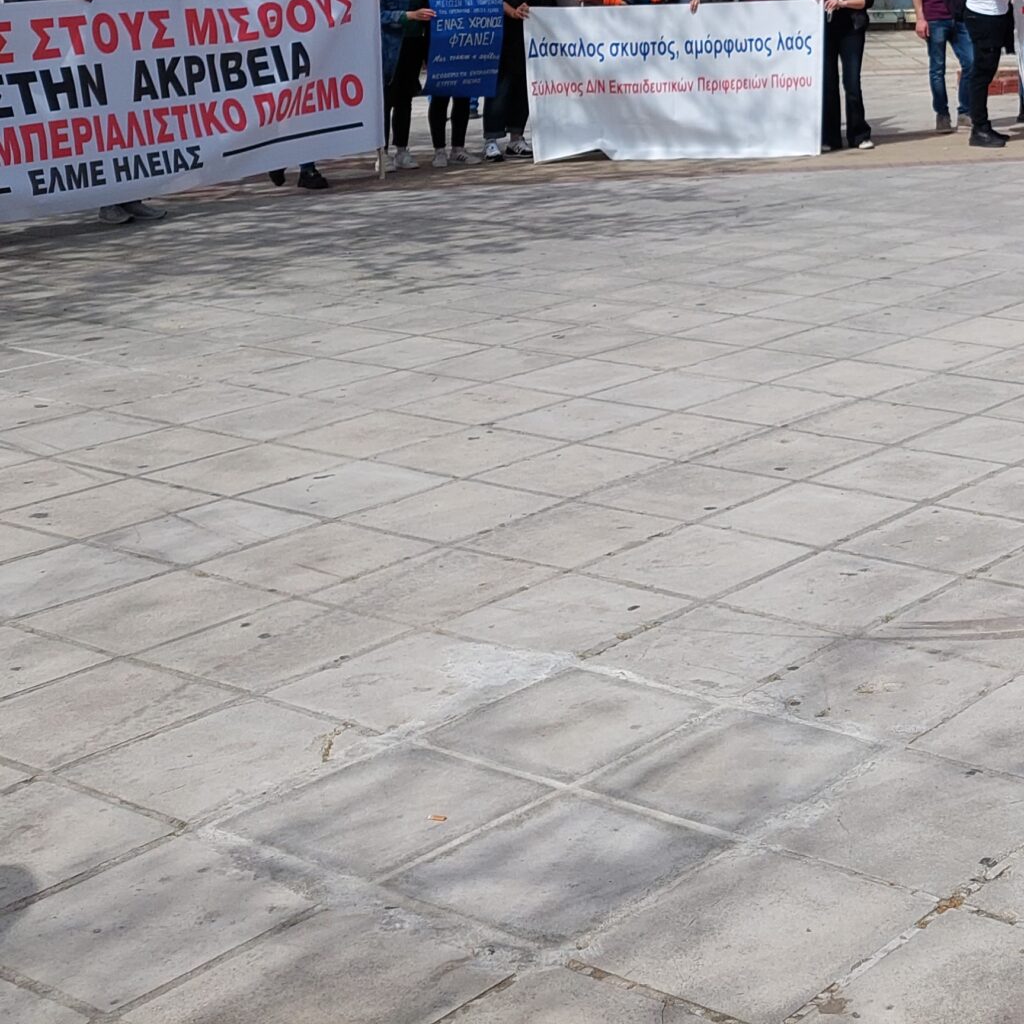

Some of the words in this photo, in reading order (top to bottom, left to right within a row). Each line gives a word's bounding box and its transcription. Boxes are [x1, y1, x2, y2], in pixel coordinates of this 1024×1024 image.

[30, 10, 175, 62] ΣΤΟΥΣ
[528, 36, 604, 62] Δάσκαλος
[609, 35, 680, 62] σκυφτός,
[684, 34, 772, 61] αμόρφωτος
[777, 31, 812, 55] λαός
[133, 41, 311, 103] ΑΚΡΙΒΕΙΑ
[531, 80, 583, 97] Σύλλογος
[609, 77, 693, 95] Εκπαιδευτικών
[697, 75, 768, 93] Περιφερειών
[771, 74, 812, 91] Πύργου
[253, 74, 364, 128] ΠΟΛΕΜΟ
[28, 160, 107, 197] ΕΛΜΕ
[113, 145, 205, 183] ΗΛΕΙΑΣ
